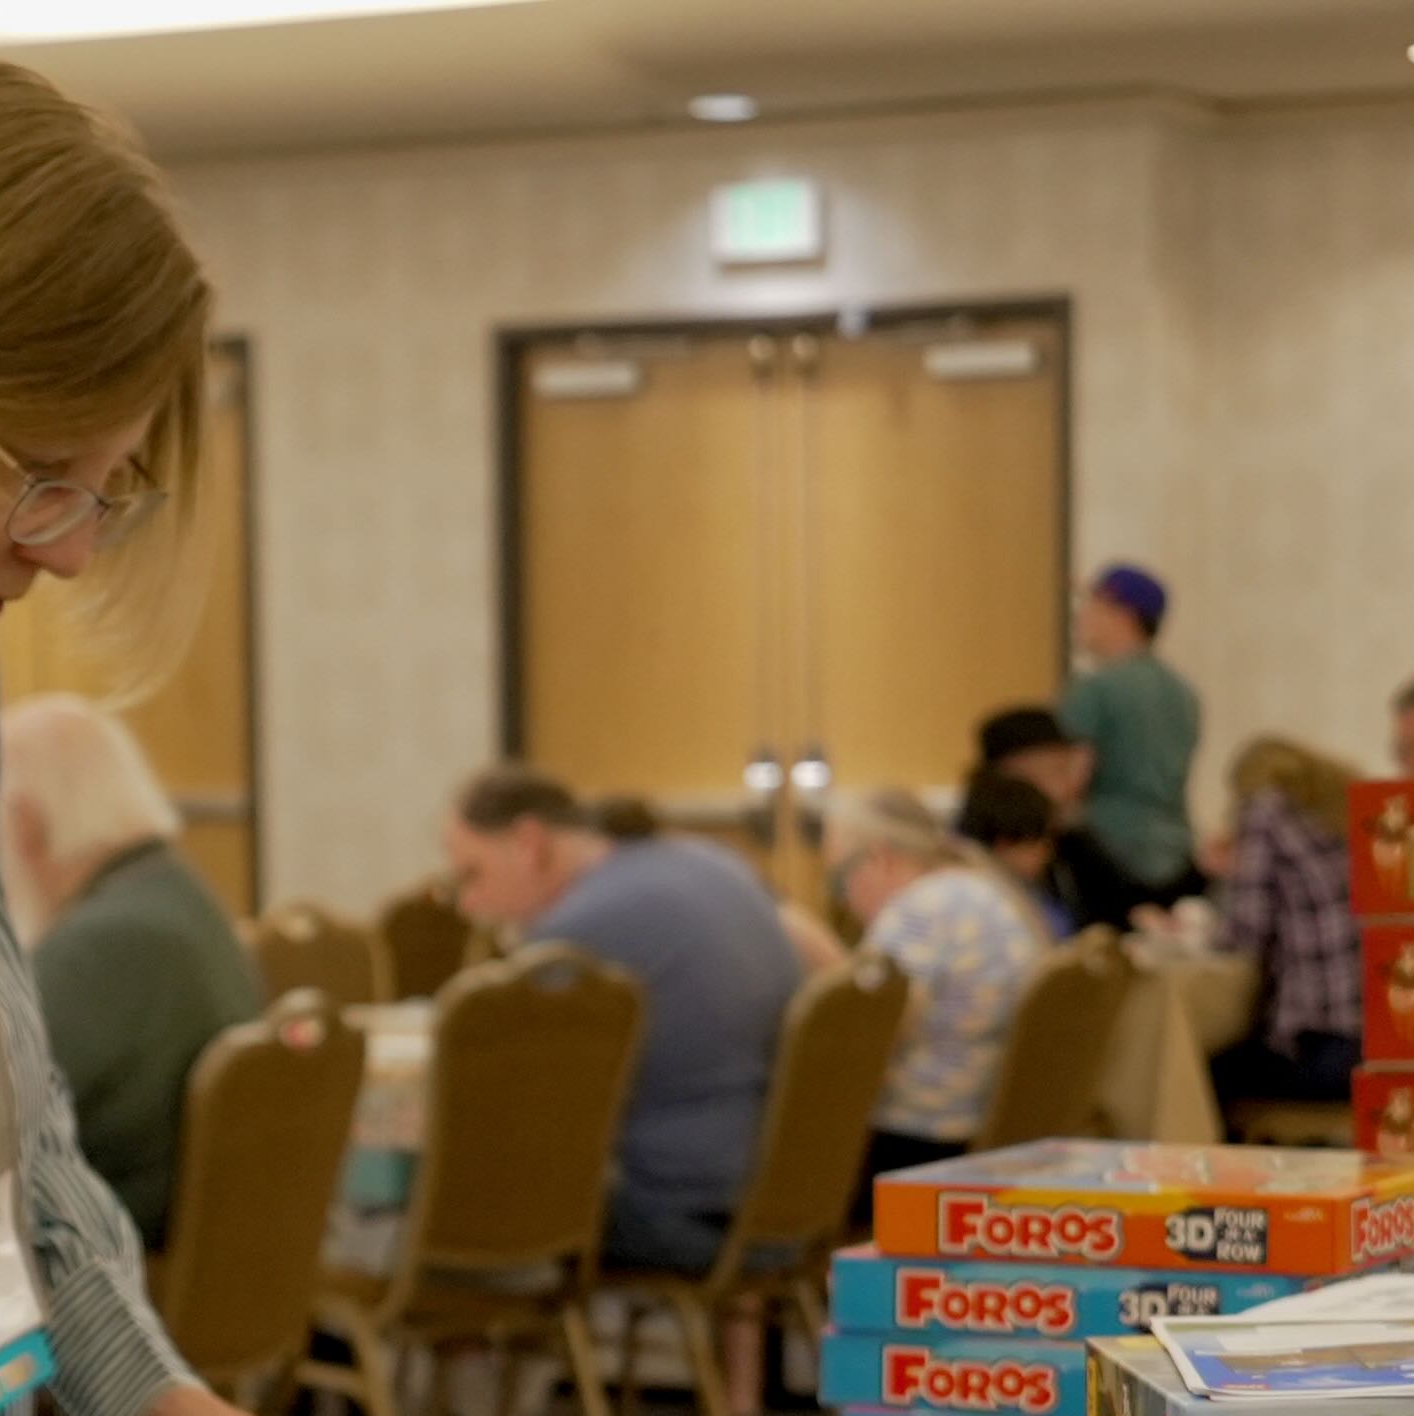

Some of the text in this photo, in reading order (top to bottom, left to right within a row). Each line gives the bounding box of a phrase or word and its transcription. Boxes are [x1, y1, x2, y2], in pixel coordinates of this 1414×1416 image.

[939, 1193, 1121, 1258] FOROS
[1165, 1212, 1215, 1252] 3D
[1217, 1241, 1264, 1264] ROW
[896, 1267, 1075, 1335] FOROS
[883, 1346, 1057, 1414] FOROS
